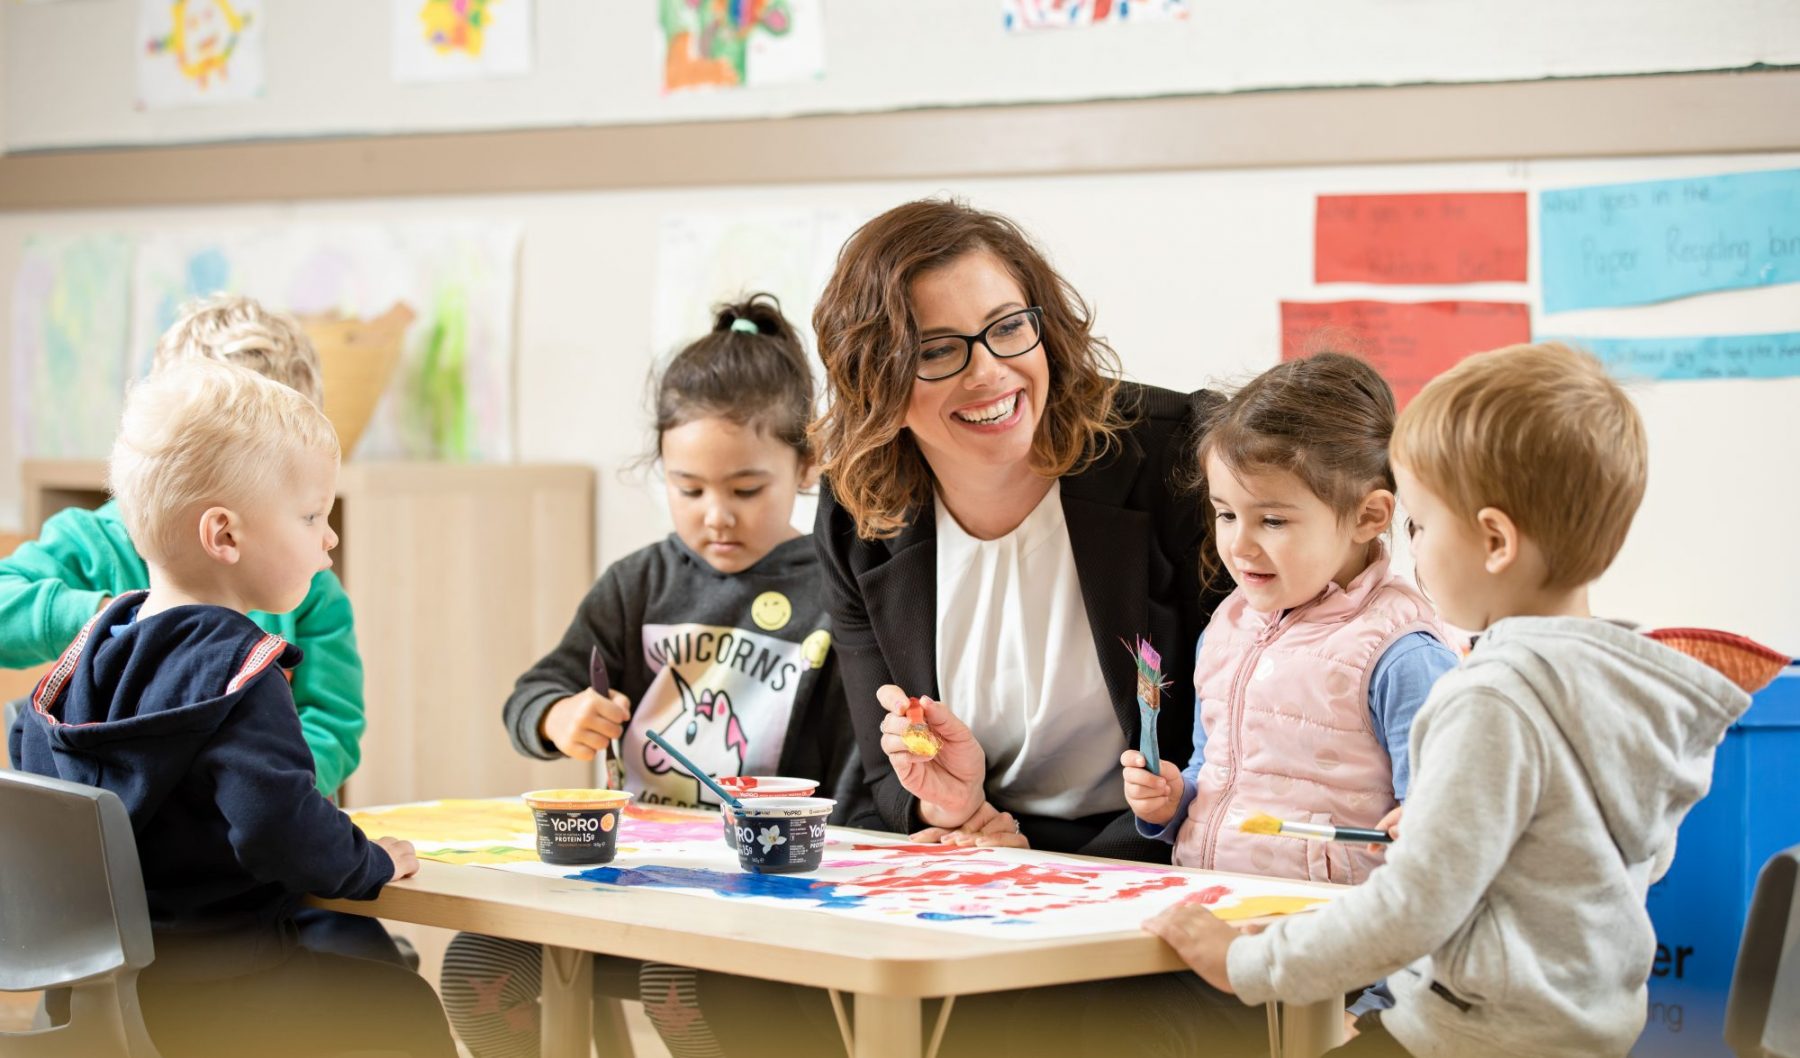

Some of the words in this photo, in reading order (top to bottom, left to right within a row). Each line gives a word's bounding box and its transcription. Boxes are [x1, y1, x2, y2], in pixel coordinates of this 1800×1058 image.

[1582, 233, 1638, 287] Paper
[1666, 224, 1751, 277] Recycling
[550, 818, 599, 832] YoPRO
[737, 827, 755, 844] RO
[809, 822, 827, 838] YoP
[1651, 941, 1694, 979] er
[1650, 1001, 1684, 1033] ng
